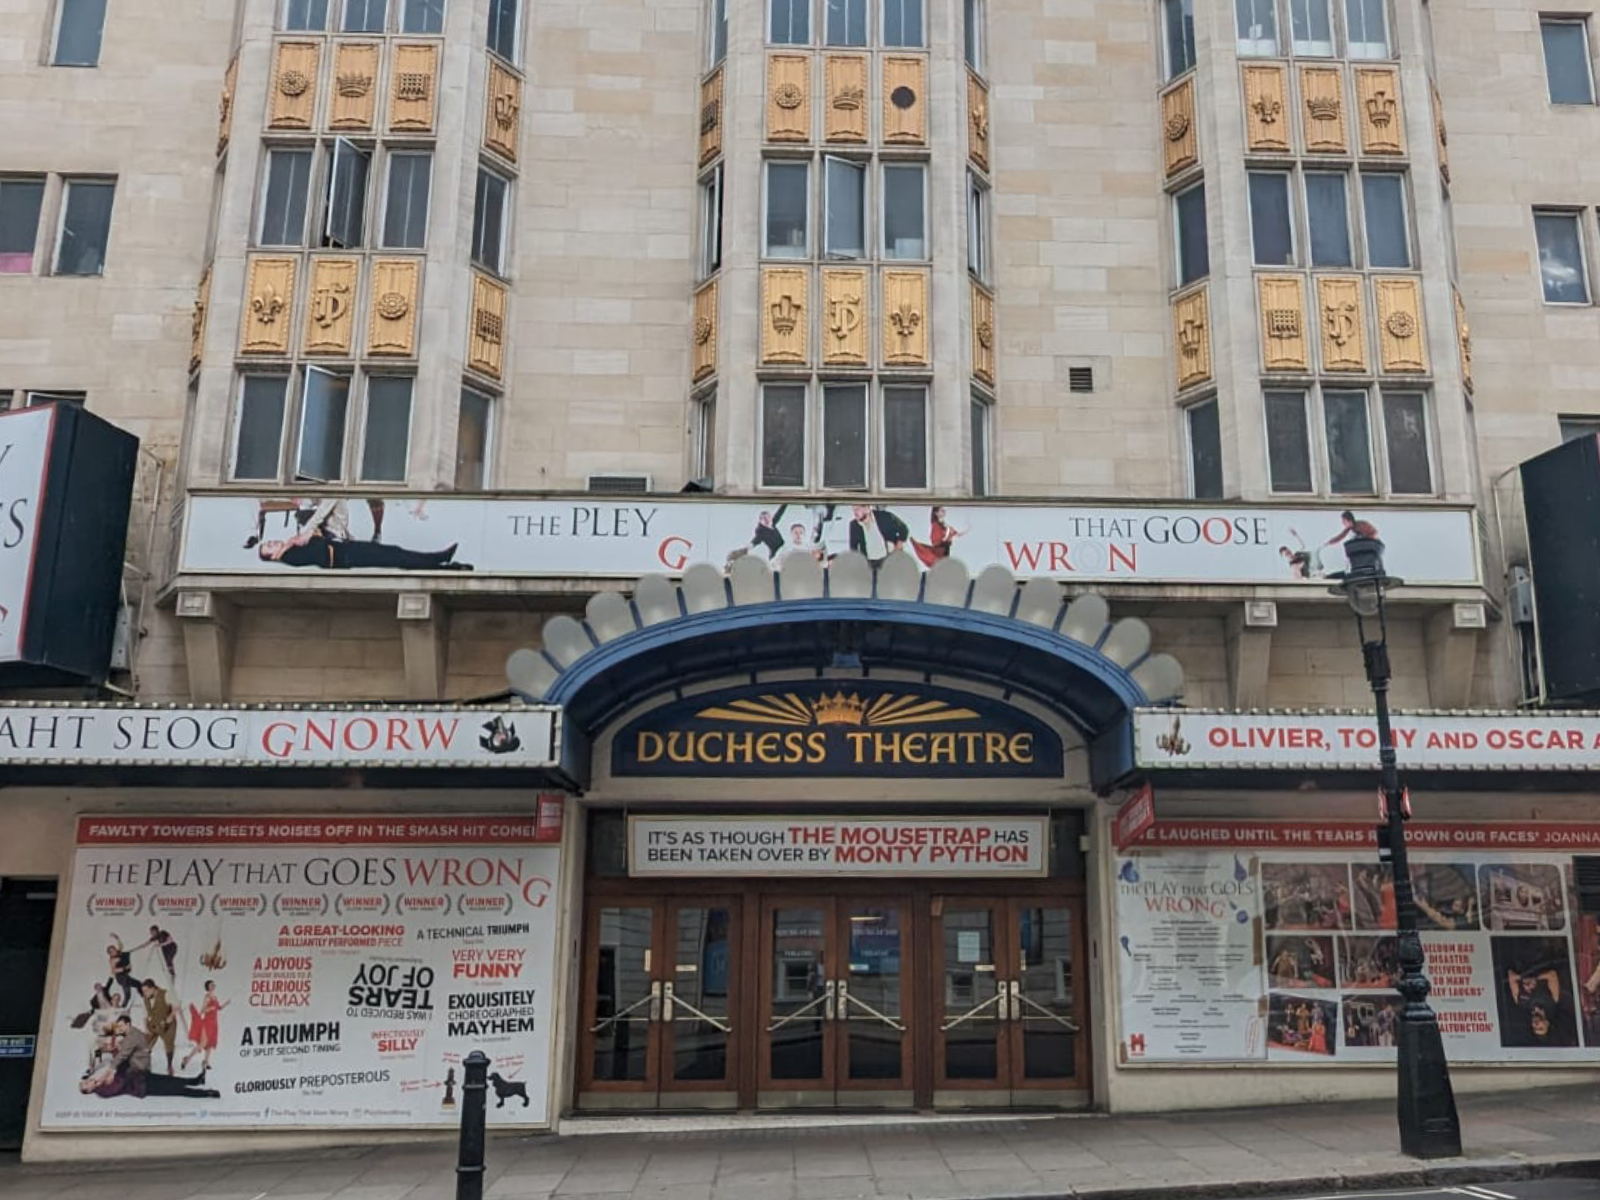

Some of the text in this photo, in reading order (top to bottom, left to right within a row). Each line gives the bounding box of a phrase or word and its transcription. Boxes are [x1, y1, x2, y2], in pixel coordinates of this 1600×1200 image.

[507, 507, 659, 537] THE PLEY
[1069, 516, 1268, 545] THAT GOOSE
[658, 535, 693, 571] G
[113, 716, 240, 751] SEOG
[261, 717, 460, 758] GNORW
[1208, 727, 1332, 751] OLIVIER,
[1426, 732, 1479, 750] AND
[1485, 729, 1585, 750] OSCAR
[637, 730, 1035, 764] DUCHESS THEATRE
[89, 825, 536, 837] FAWLTY TOWERS MEETS NOISES OFF IN THE SMASH HIT COME
[647, 826, 1029, 846] IT'S AS THOUGH THE MOUSETRAP HAS
[1139, 829, 1156, 840] E
[1159, 828, 1230, 840] LAUGHED
[1234, 829, 1277, 841] UNTIL
[1283, 830, 1311, 841] THE
[1314, 830, 1365, 842] TEARS
[1404, 830, 1450, 842] DOWN
[1453, 830, 1486, 842] OUR
[1489, 830, 1540, 843] FACES'
[1543, 831, 1600, 843] JOANNA
[647, 845, 1029, 863] BEEN TAKEN OVER BY MONTY PYTHON
[86, 857, 552, 908] THE PLAY THAT GOES WRONG
[95, 897, 505, 907] WINNER WINNER WINNER WINNER WINNER WINNER WINNER
[1144, 896, 1228, 919] WRONG
[279, 925, 405, 937] A GREAT-LOOKING
[417, 923, 530, 941] A TECHNICAL TRIUMPH
[278, 938, 404, 948] BRILLIANTLY PERFORMED PIECE
[253, 956, 313, 971] A JOYOUS
[453, 949, 526, 962] VERY VERY
[352, 963, 435, 989] OF JOY
[453, 963, 523, 979] FUNNY
[251, 980, 312, 993] DELIRIOUS
[249, 993, 311, 1007] CLIMAX
[348, 985, 434, 1010] TEARS
[448, 989, 536, 1010] EXQUISITELY
[346, 1007, 359, 1018] TO
[360, 1008, 405, 1020] REDUCED
[448, 1006, 535, 1021] CHOREOGRAPHED
[1435, 1011, 1488, 1022] ASTERPIECE
[241, 1021, 341, 1047] A TRIUMPH
[448, 1017, 535, 1038] MAYHEM
[239, 1049, 251, 1058] OF
[252, 1047, 275, 1057] SPLIT
[377, 1038, 418, 1053] SILLY
[234, 1078, 297, 1094] GLORIOUSLY
[299, 1069, 391, 1089] PREPOSTEROUS
